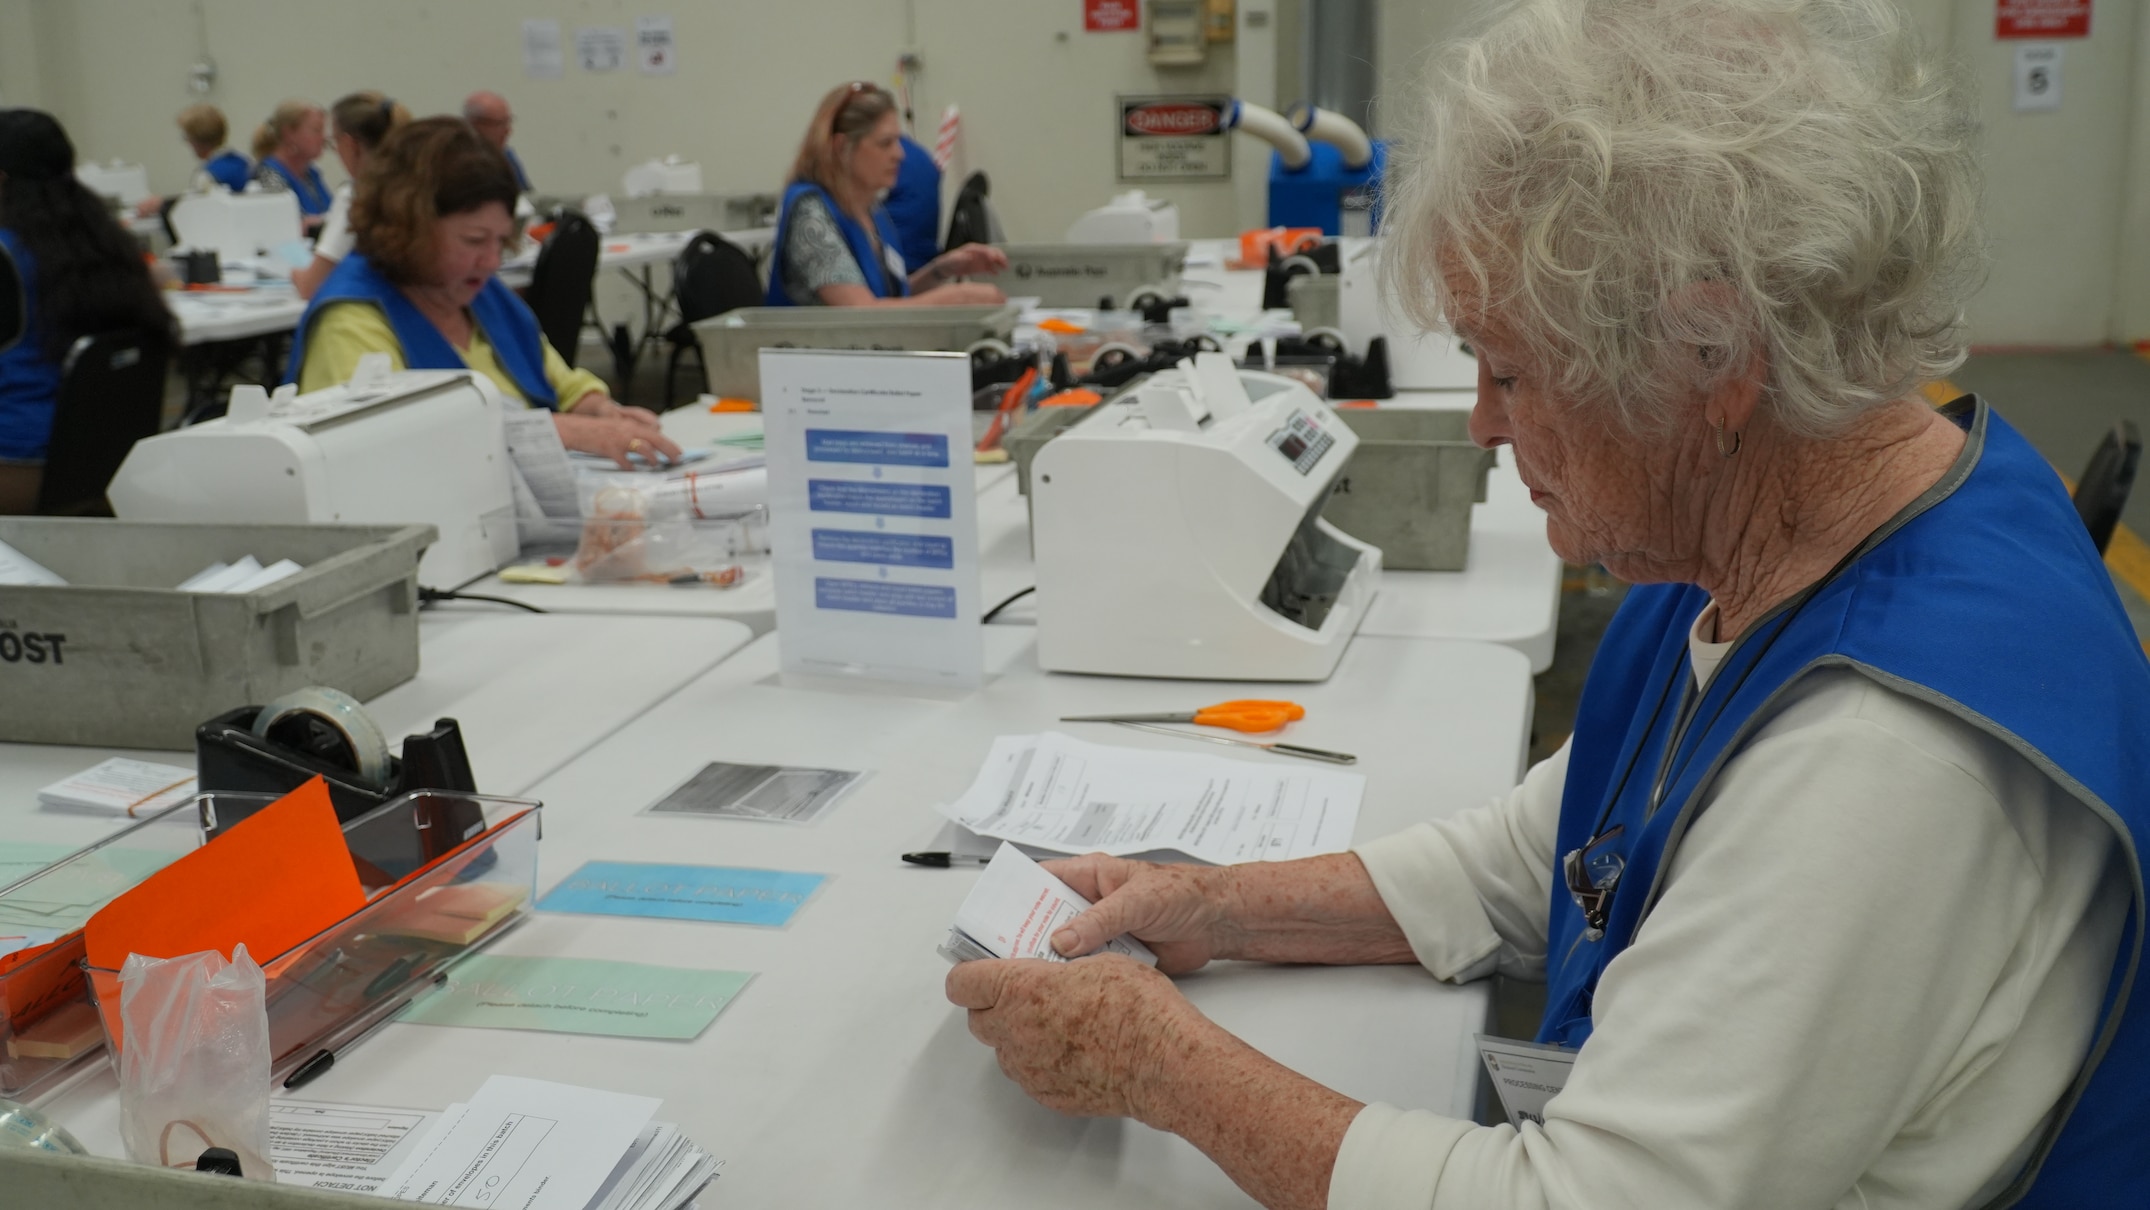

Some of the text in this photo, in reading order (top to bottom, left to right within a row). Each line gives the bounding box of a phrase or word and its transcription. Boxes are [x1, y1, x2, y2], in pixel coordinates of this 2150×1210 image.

[1137, 111, 1213, 128] DANGER
[454, 1160, 484, 1190] envelopes
[485, 1139, 499, 1152] this
[495, 1121, 514, 1140] batch
[312, 1180, 378, 1192] NOT DETACH
